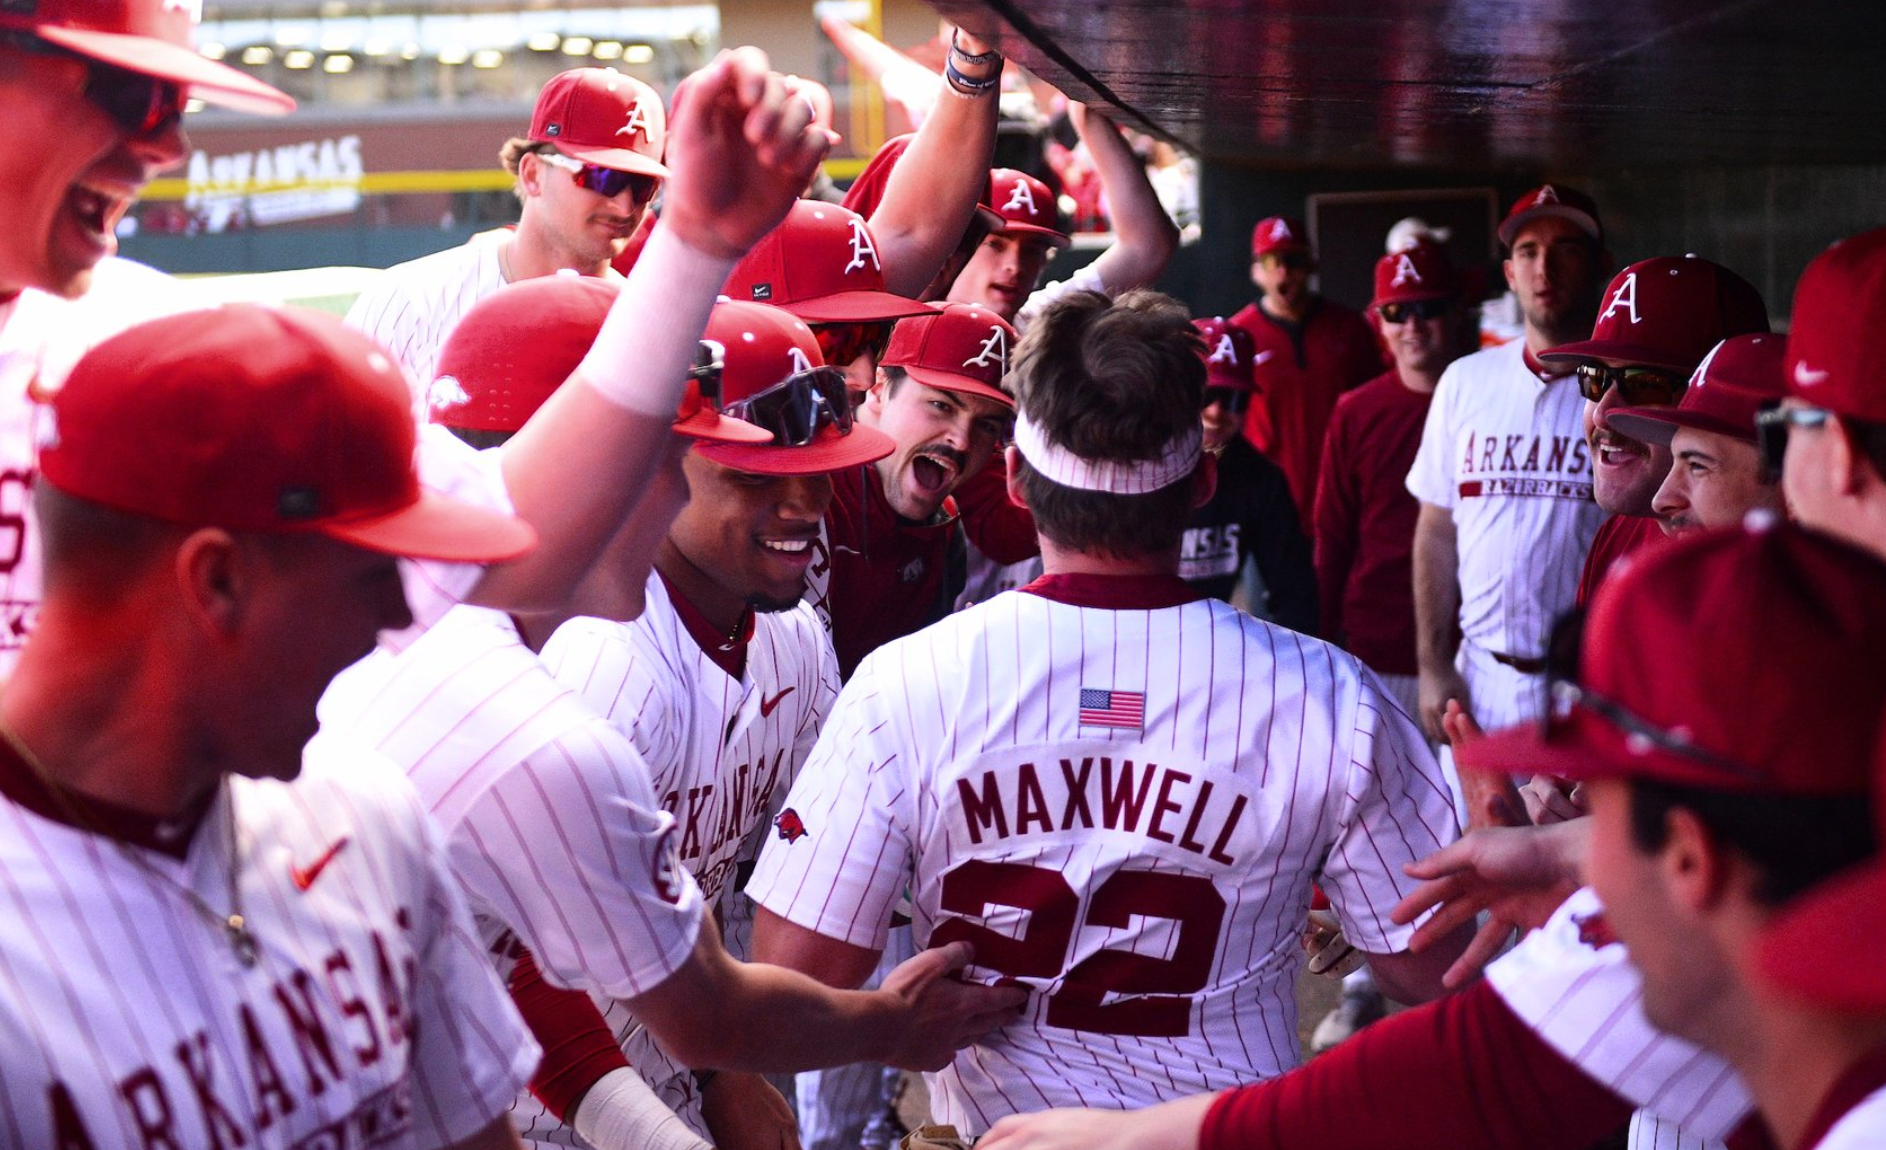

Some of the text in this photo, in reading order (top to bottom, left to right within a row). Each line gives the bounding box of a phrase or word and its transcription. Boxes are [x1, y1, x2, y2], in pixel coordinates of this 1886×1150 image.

[1001, 178, 1039, 216] A
[844, 219, 881, 275] A
[1268, 218, 1293, 243] A
[1390, 253, 1423, 288] A
[1598, 272, 1643, 325] A
[962, 325, 1006, 378] A
[1208, 333, 1238, 365] A
[1462, 430, 1593, 476] ARKANS
[956, 756, 1249, 867] MAXWELL
[929, 858, 1227, 1038] 22
